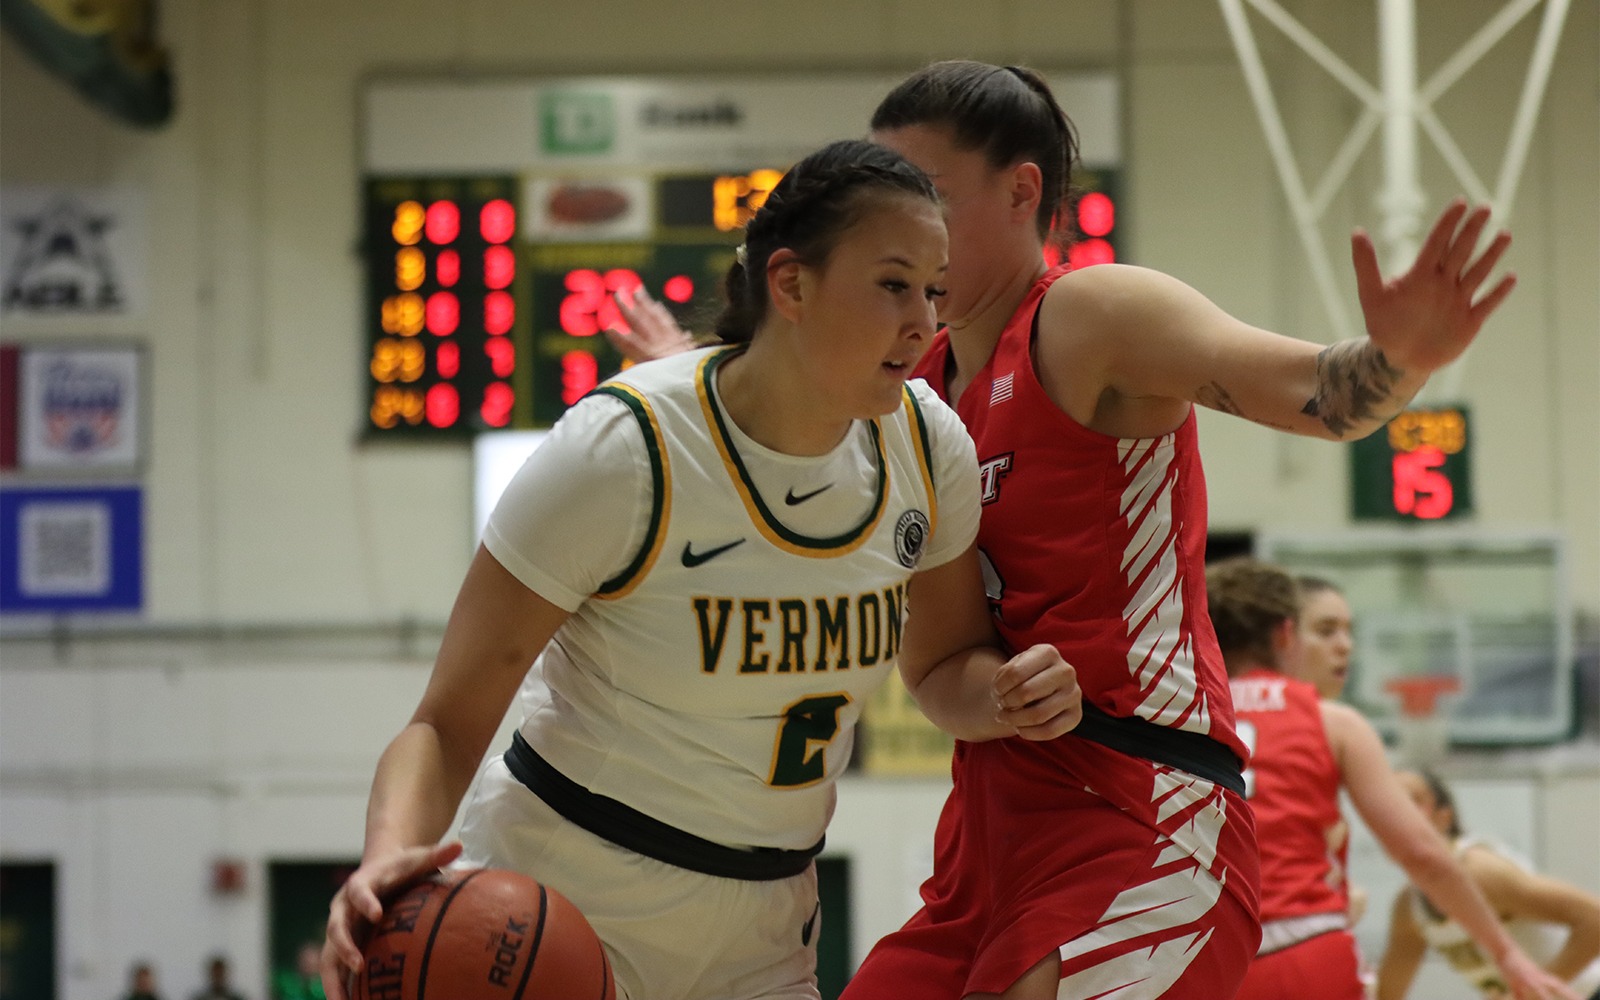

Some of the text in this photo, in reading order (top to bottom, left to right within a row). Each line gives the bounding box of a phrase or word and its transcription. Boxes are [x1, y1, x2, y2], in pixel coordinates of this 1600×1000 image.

[1392, 445, 1454, 519] 15
[691, 582, 908, 676] VERMON
[766, 691, 854, 790] 2
